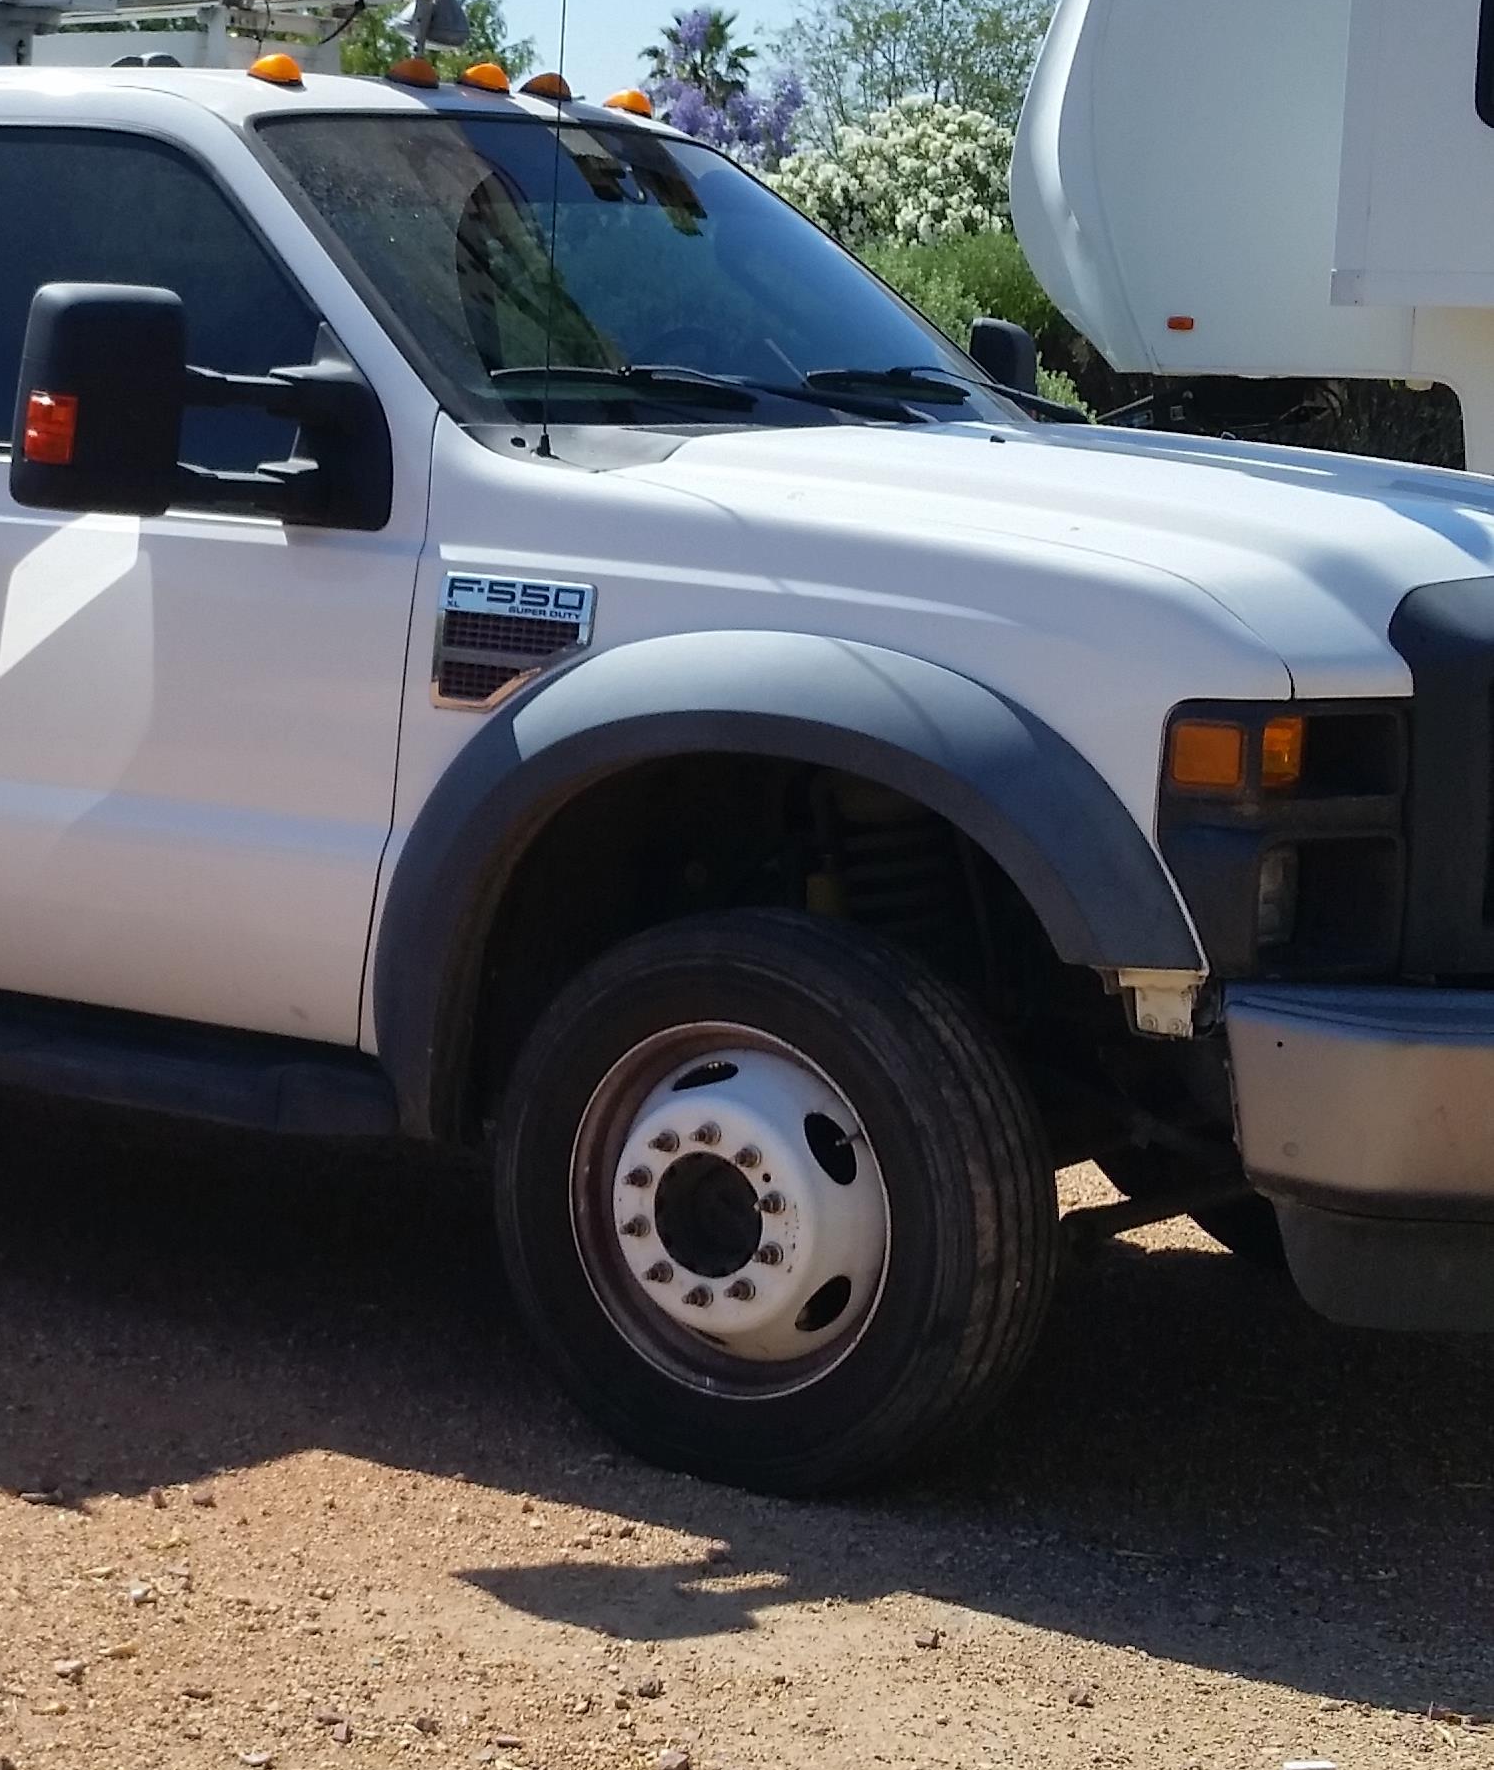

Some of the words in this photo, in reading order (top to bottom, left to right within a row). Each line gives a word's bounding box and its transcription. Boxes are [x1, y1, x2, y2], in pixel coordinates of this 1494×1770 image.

[447, 578, 585, 611] F-550
[508, 606, 546, 617] SUPER
[549, 609, 581, 620] DUTY
